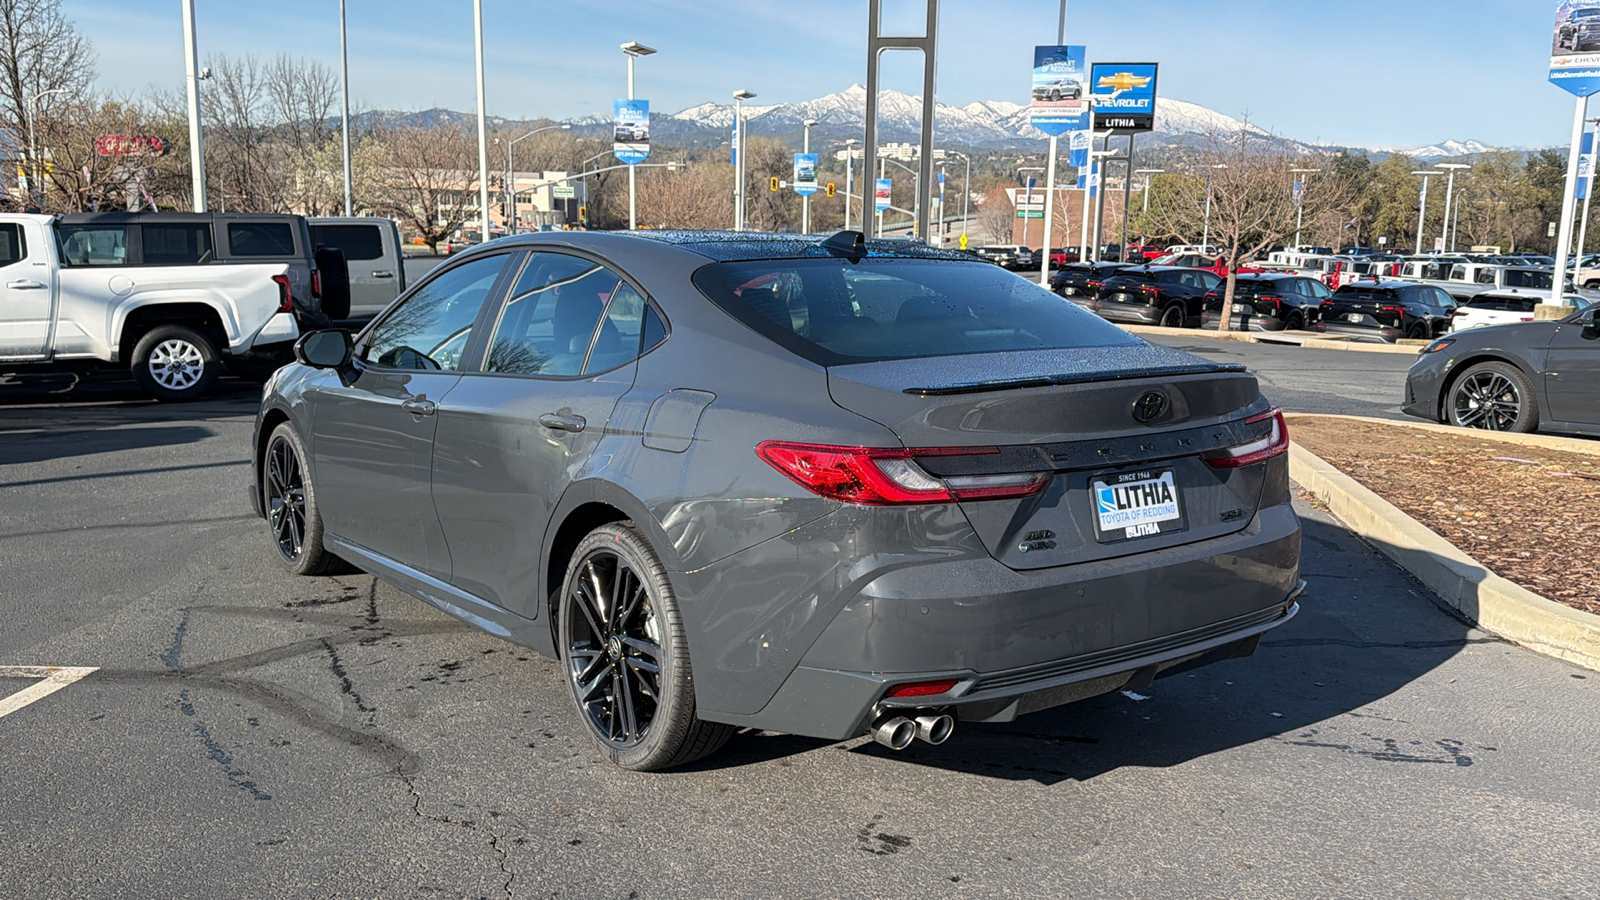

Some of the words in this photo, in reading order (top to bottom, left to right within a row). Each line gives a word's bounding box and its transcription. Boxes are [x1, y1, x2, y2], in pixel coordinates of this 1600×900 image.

[1095, 98, 1149, 108] CHEVROLET
[1105, 118, 1136, 127] LITHIA
[1118, 474, 1136, 483] SINCE
[1137, 472, 1151, 480] 1946
[1114, 481, 1174, 511] LITHIA
[1101, 511, 1131, 525] TOYOTA
[1131, 510, 1141, 520] OF
[1143, 504, 1176, 519] REDDING
[1133, 522, 1161, 537] LITHIA
